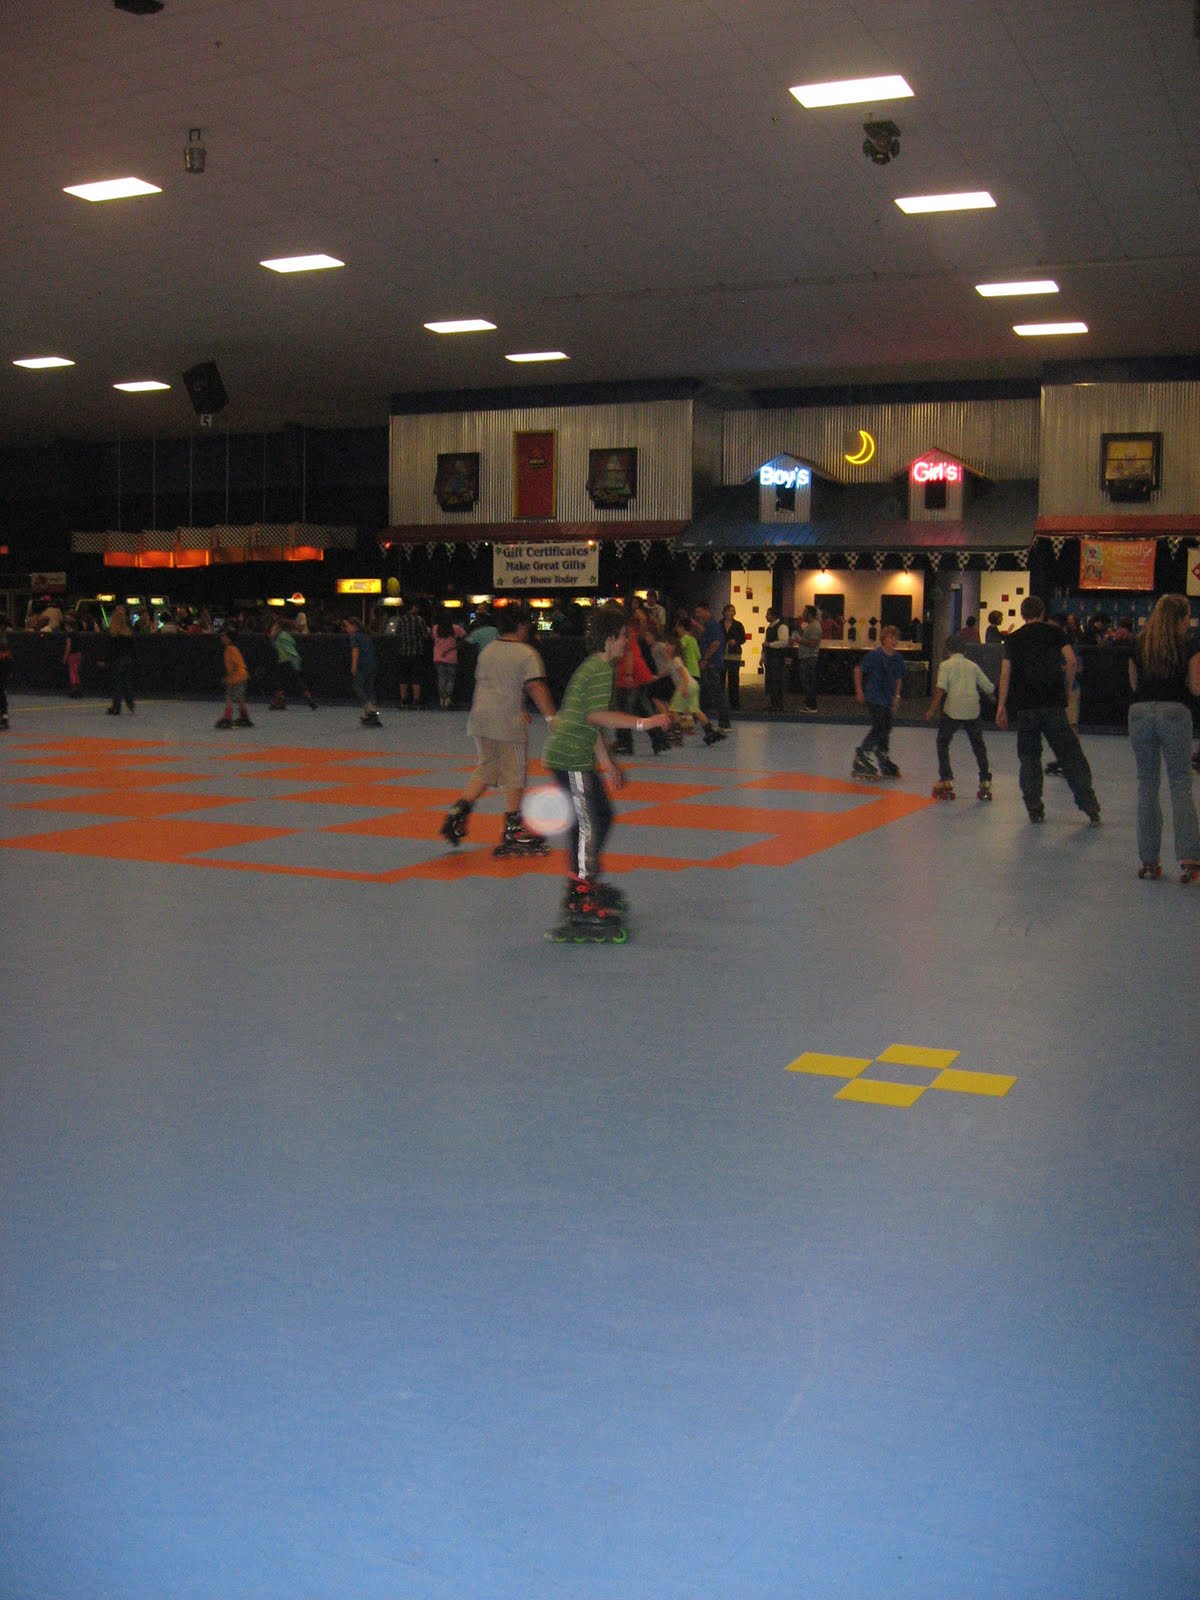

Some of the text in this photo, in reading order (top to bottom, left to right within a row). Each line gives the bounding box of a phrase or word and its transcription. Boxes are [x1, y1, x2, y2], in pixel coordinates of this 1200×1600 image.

[759, 466, 809, 489] Boy's
[913, 461, 958, 482] Girl's
[503, 545, 589, 558] Gift Certificates
[506, 560, 586, 571] Make Great Gifts
[513, 575, 579, 585] Get Yours Today
